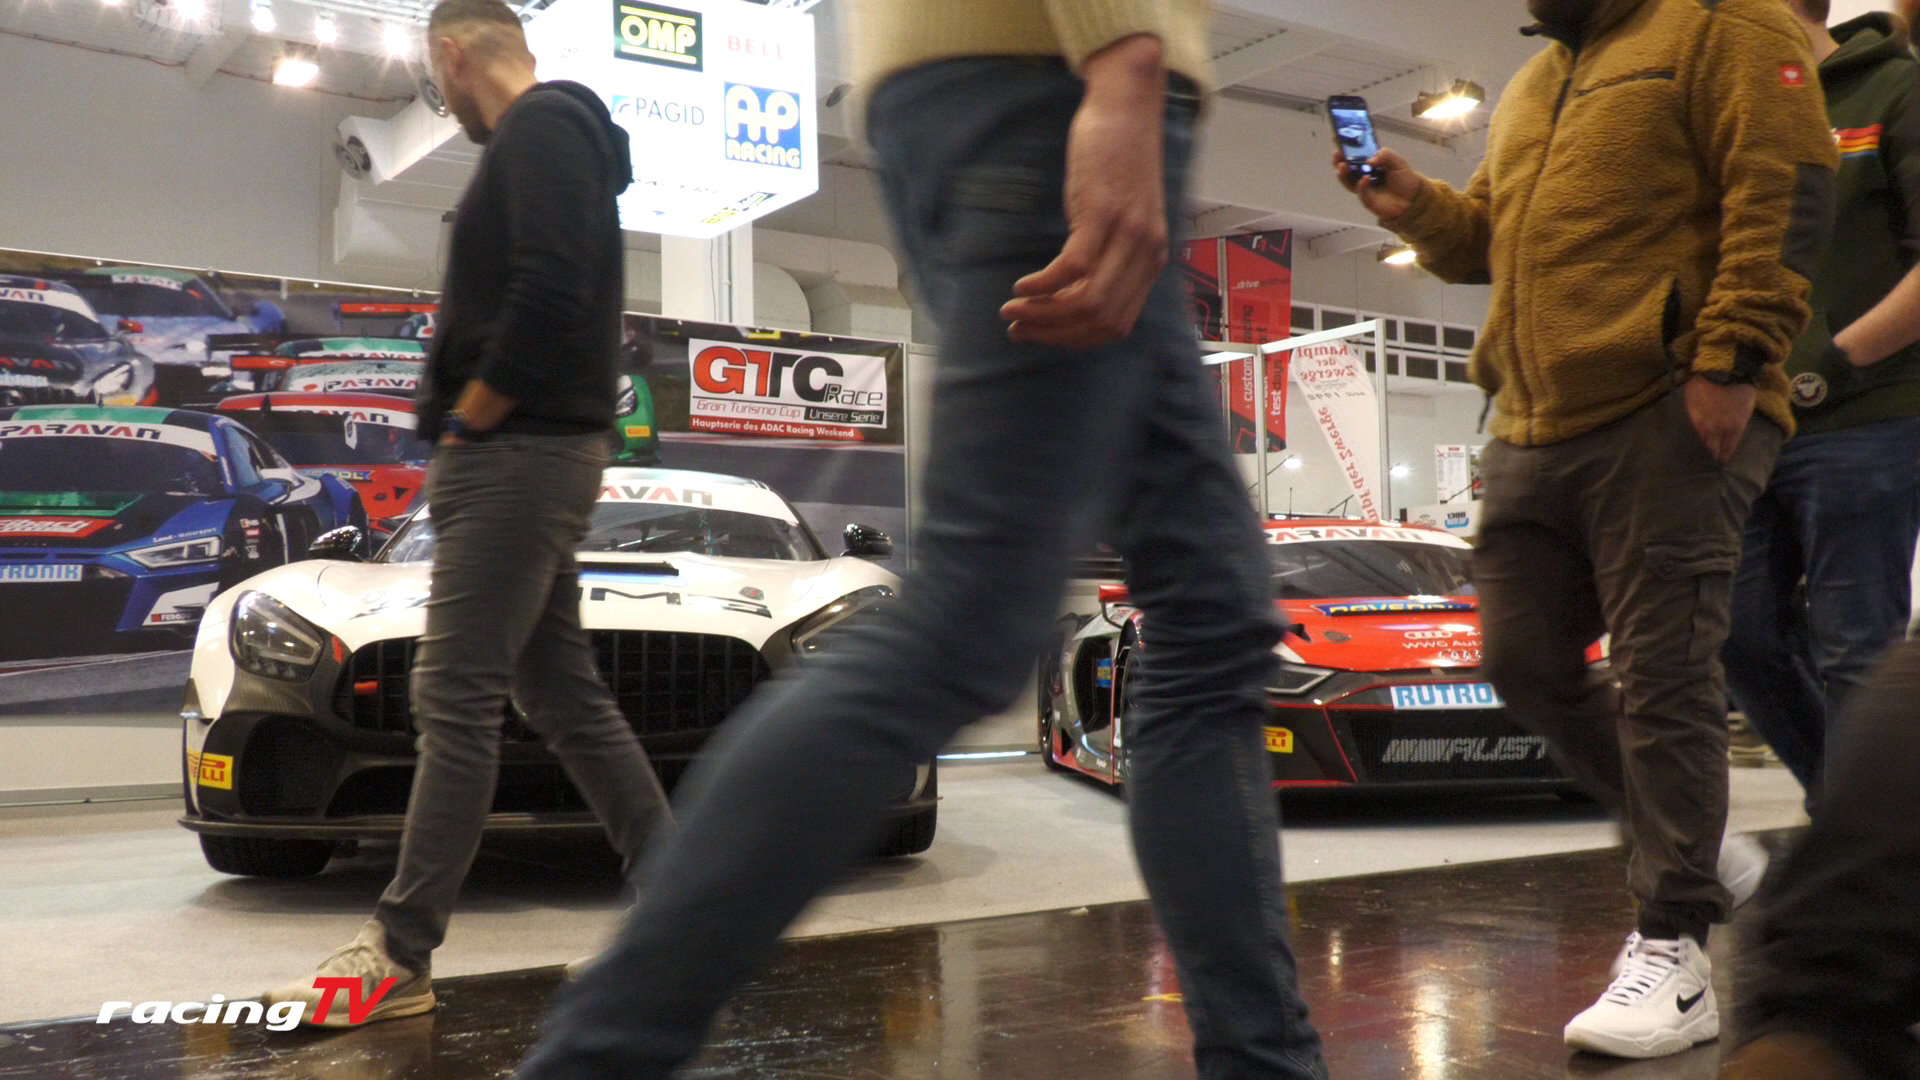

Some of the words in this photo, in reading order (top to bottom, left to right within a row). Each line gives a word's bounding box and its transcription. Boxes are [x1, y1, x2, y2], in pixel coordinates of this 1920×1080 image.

[620, 15, 697, 54] OMP
[727, 35, 785, 60] BELL
[636, 96, 706, 126] PAGID
[725, 84, 800, 145] AP
[727, 139, 800, 168] RACING
[328, 378, 417, 389] PARAVA
[824, 383, 883, 407] Race
[696, 400, 726, 413] Gran
[730, 402, 777, 416] Turismo
[780, 407, 801, 420] Cup
[809, 408, 849, 422] Unsere
[851, 413, 881, 424] Serie
[0, 424, 162, 440] PARAVAN
[692, 417, 742, 431] Hauptserie
[743, 421, 759, 432] des
[760, 423, 785, 433] ADAC
[786, 425, 815, 437] Racing
[816, 427, 855, 438] Weekend
[597, 486, 712, 506] AVAN
[1266, 528, 1425, 541] ARAVAN
[0, 565, 80, 580] TRONIK
[1402, 640, 1448, 649] WWG
[1396, 683, 1494, 707] RUTRO
